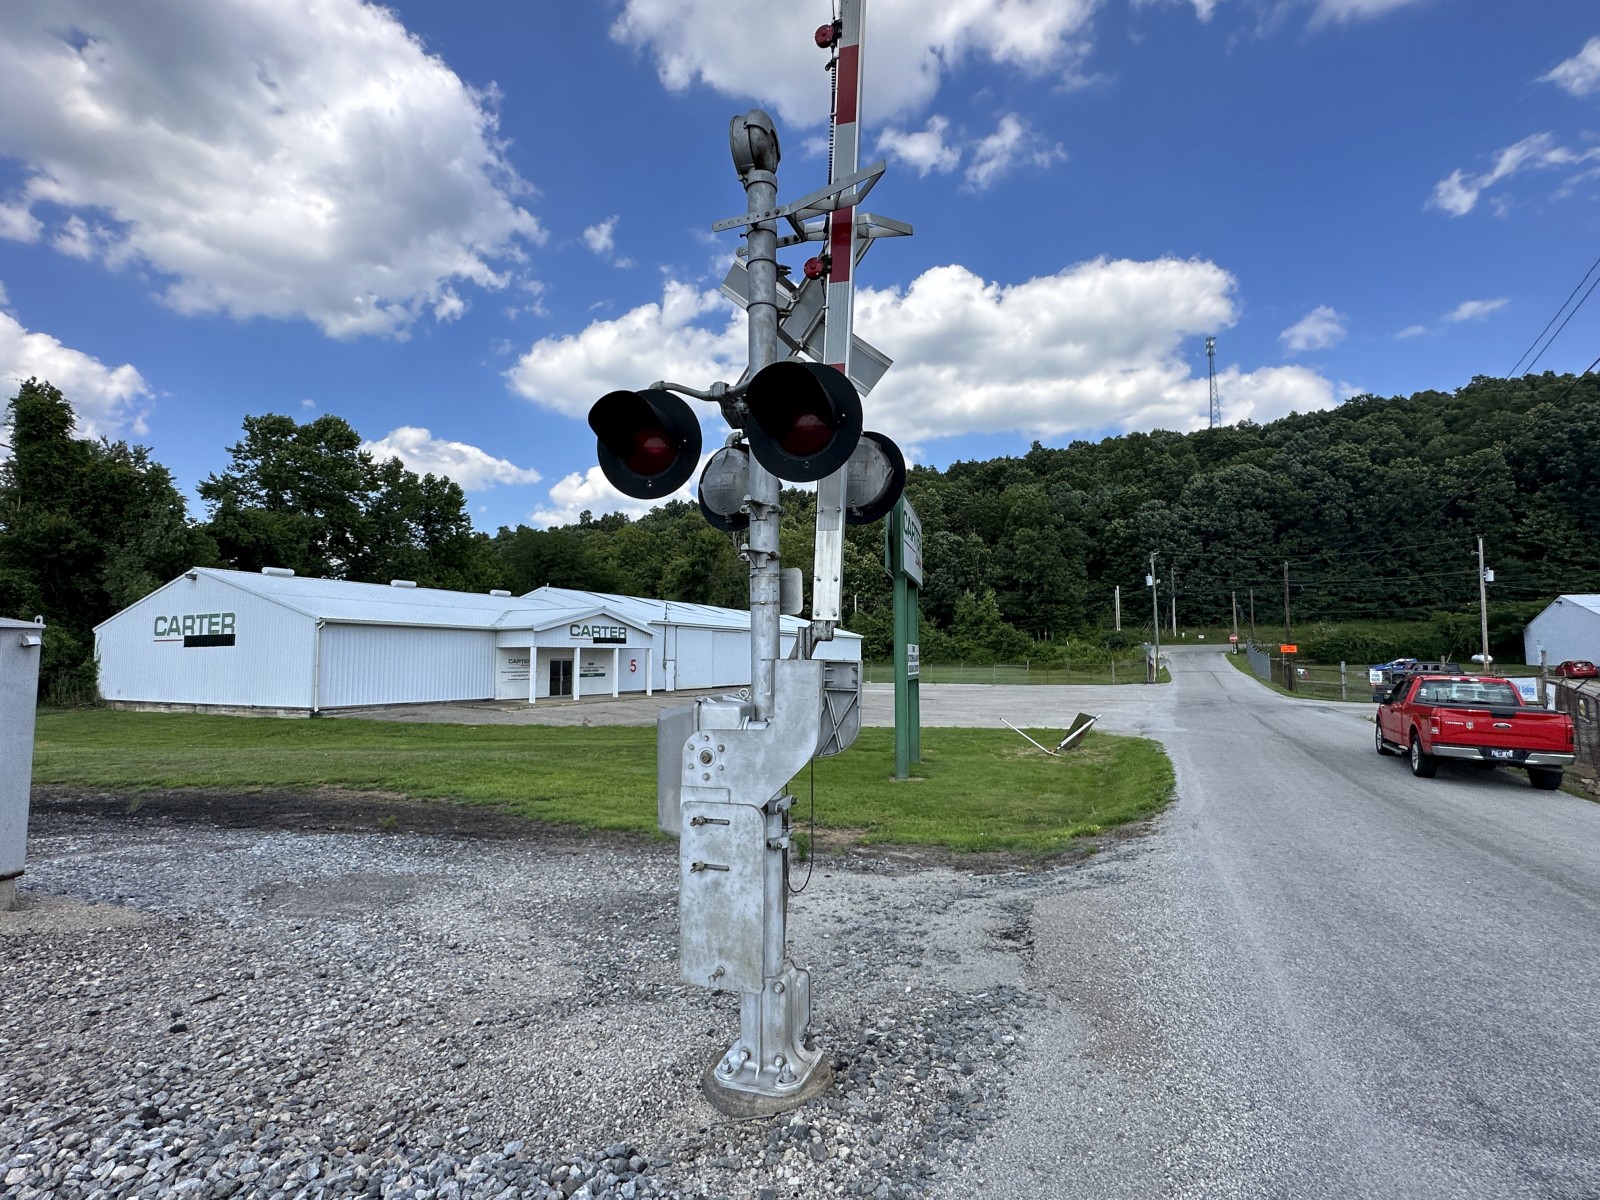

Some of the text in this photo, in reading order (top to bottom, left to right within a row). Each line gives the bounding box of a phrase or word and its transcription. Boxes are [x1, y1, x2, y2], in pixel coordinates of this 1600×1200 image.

[154, 612, 236, 636] CARTER
[570, 624, 627, 638] CARTER
[630, 659, 637, 673] 5
